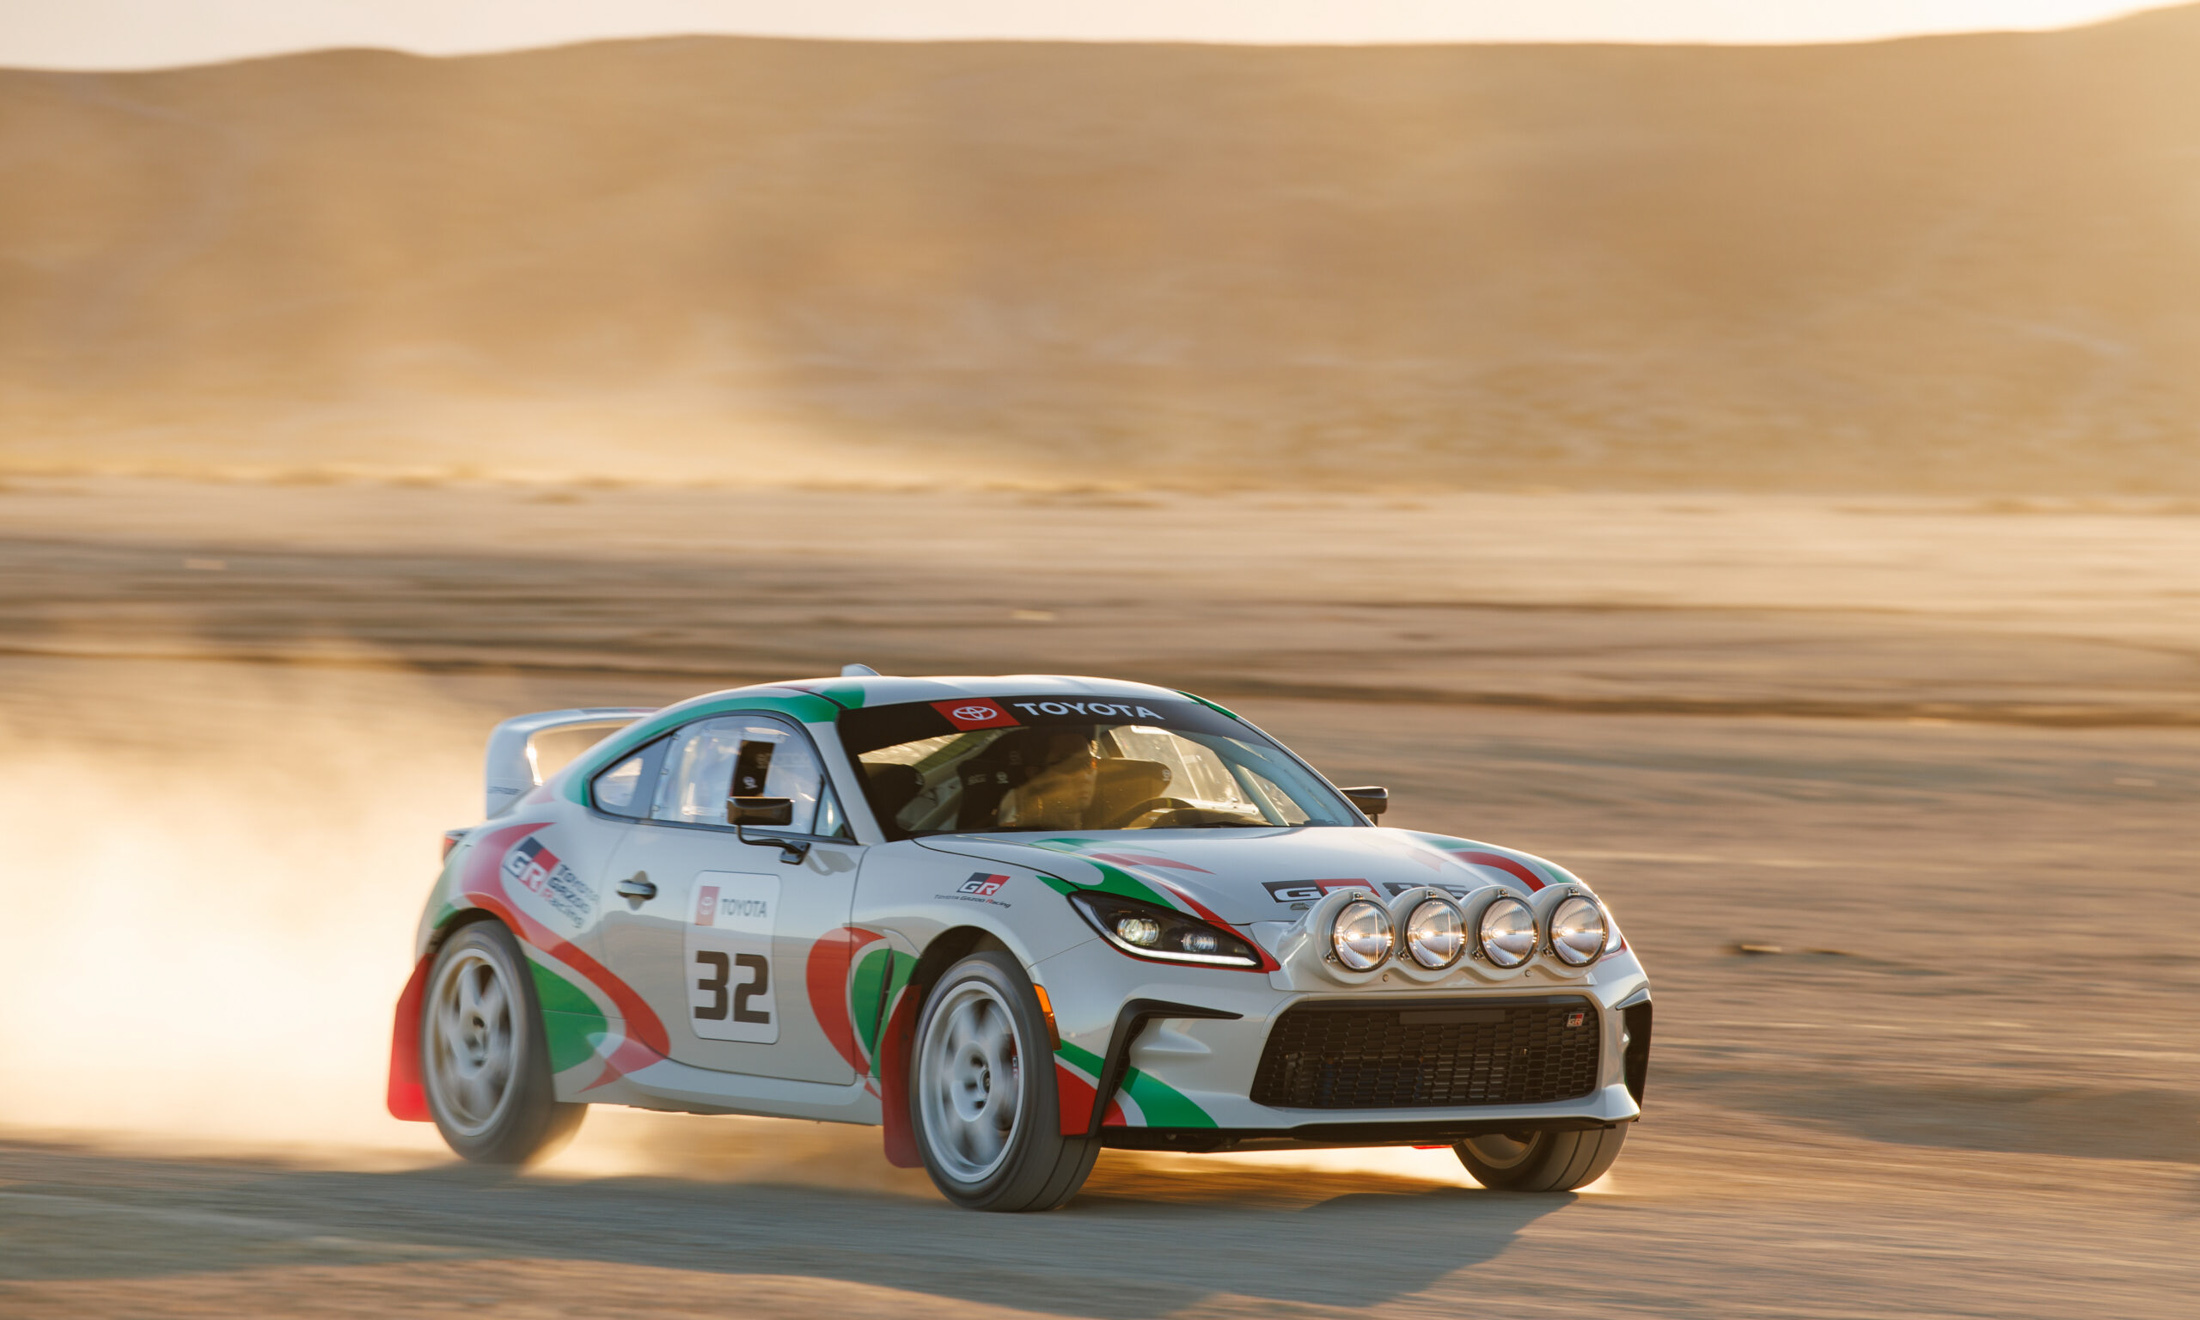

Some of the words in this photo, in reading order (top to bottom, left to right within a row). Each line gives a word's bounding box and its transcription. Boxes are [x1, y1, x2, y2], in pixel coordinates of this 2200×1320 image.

[1014, 702, 1165, 720] TOYOTA
[504, 850, 548, 892] GR
[959, 880, 1001, 895] GR
[721, 898, 767, 918] TOYOTA
[694, 950, 770, 1024] 32
